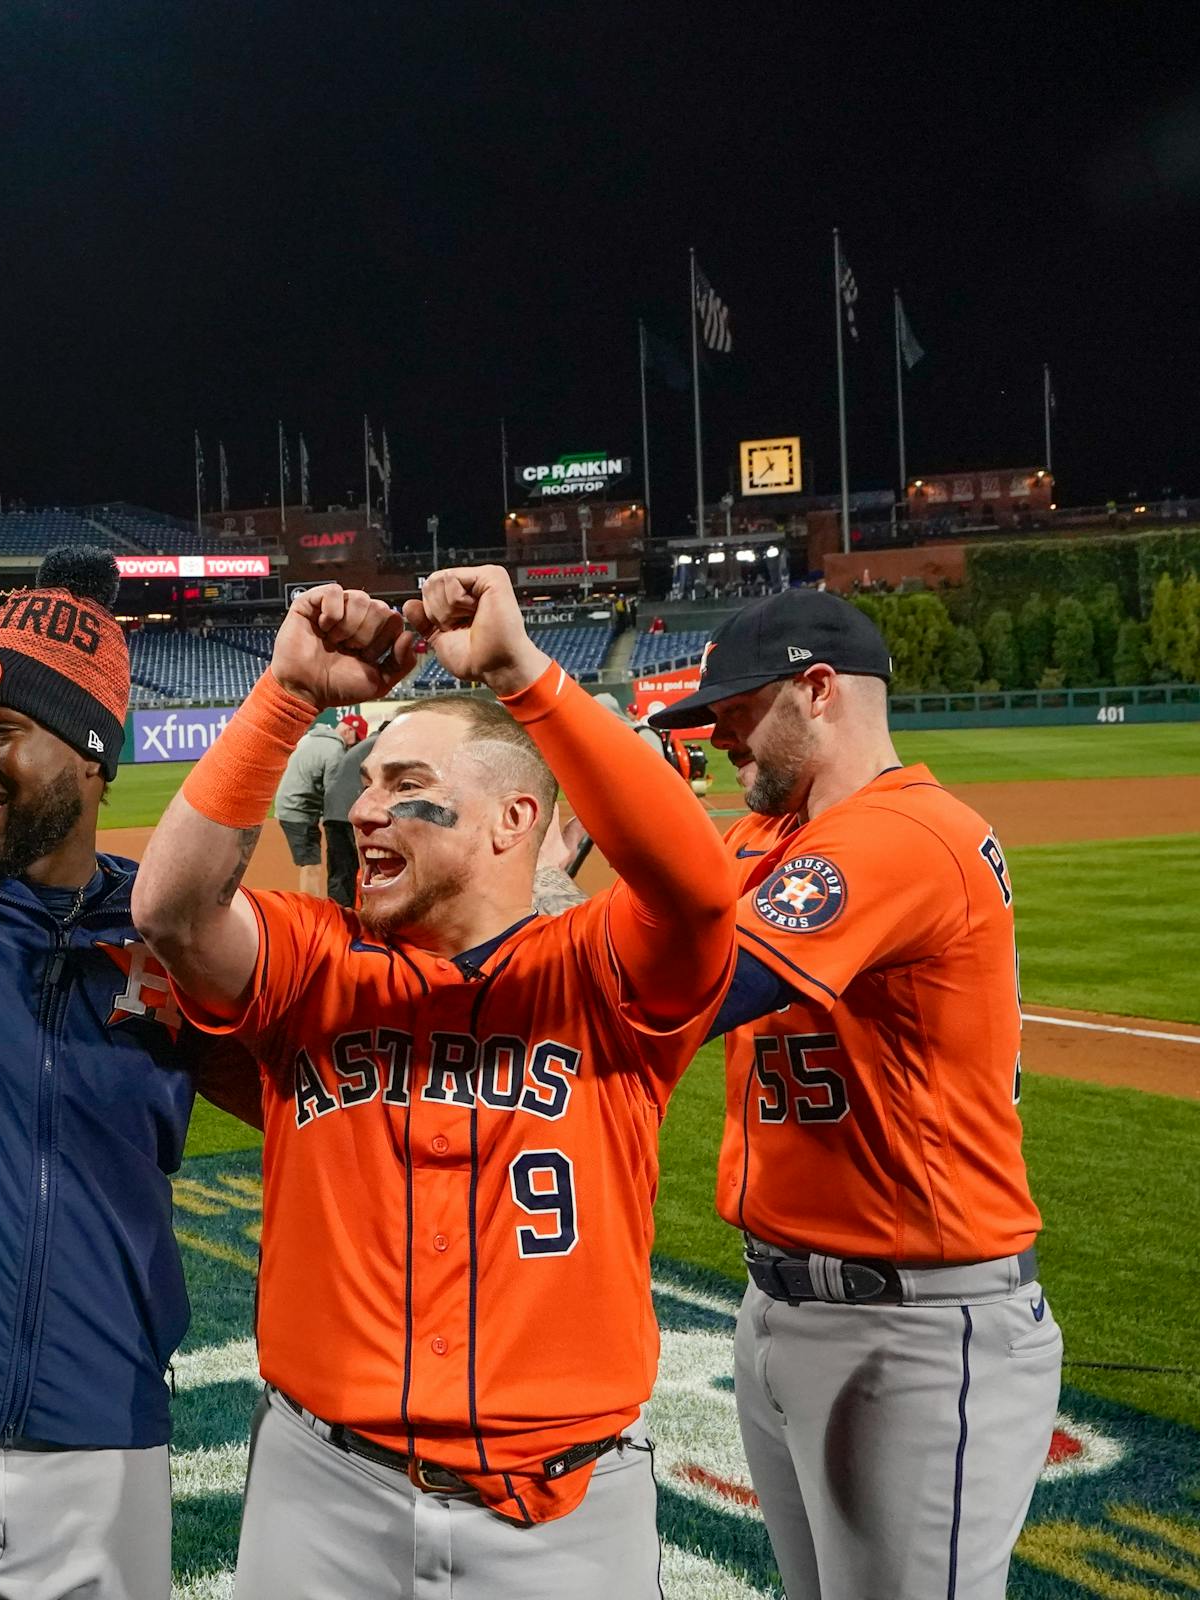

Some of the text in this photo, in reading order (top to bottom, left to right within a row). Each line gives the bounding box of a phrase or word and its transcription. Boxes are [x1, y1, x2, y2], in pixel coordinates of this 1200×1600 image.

[523, 465, 549, 481] CP
[552, 459, 622, 479] RANKIN
[542, 481, 604, 495] ROOFTOP
[301, 530, 357, 547] GIANT
[118, 560, 177, 574] TOYOTA
[207, 560, 265, 573] TOYOTA
[638, 681, 655, 691] Like
[656, 683, 661, 691] a
[663, 680, 682, 692] good
[1097, 706, 1125, 722] 401
[784, 859, 841, 895] HOUSTON
[757, 898, 808, 928] ASTROS
[294, 1026, 582, 1129] ASTROS
[754, 1032, 850, 1124] 55
[509, 1148, 579, 1259] 9
